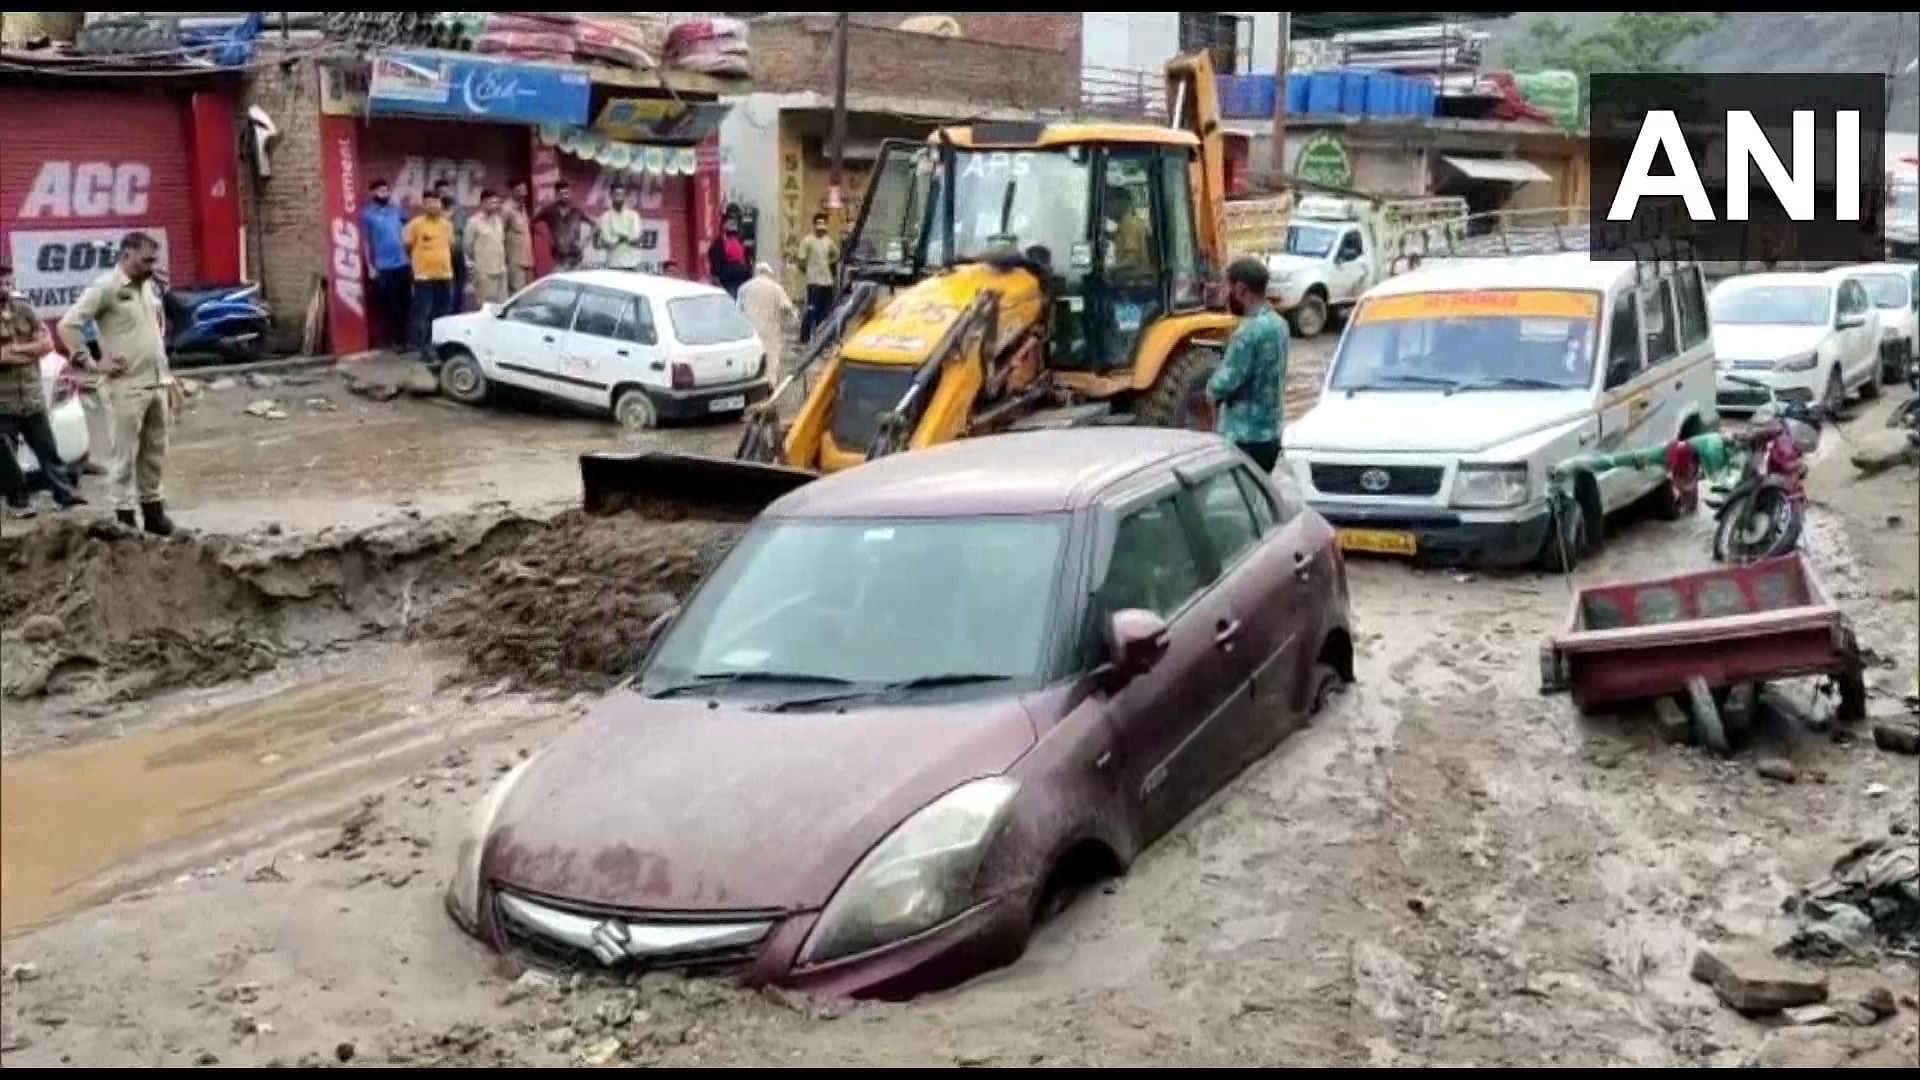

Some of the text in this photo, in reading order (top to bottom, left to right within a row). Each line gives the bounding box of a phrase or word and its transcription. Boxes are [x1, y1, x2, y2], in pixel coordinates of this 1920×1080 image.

[17, 160, 150, 218] ACC
[331, 138, 365, 318] ACC cement
